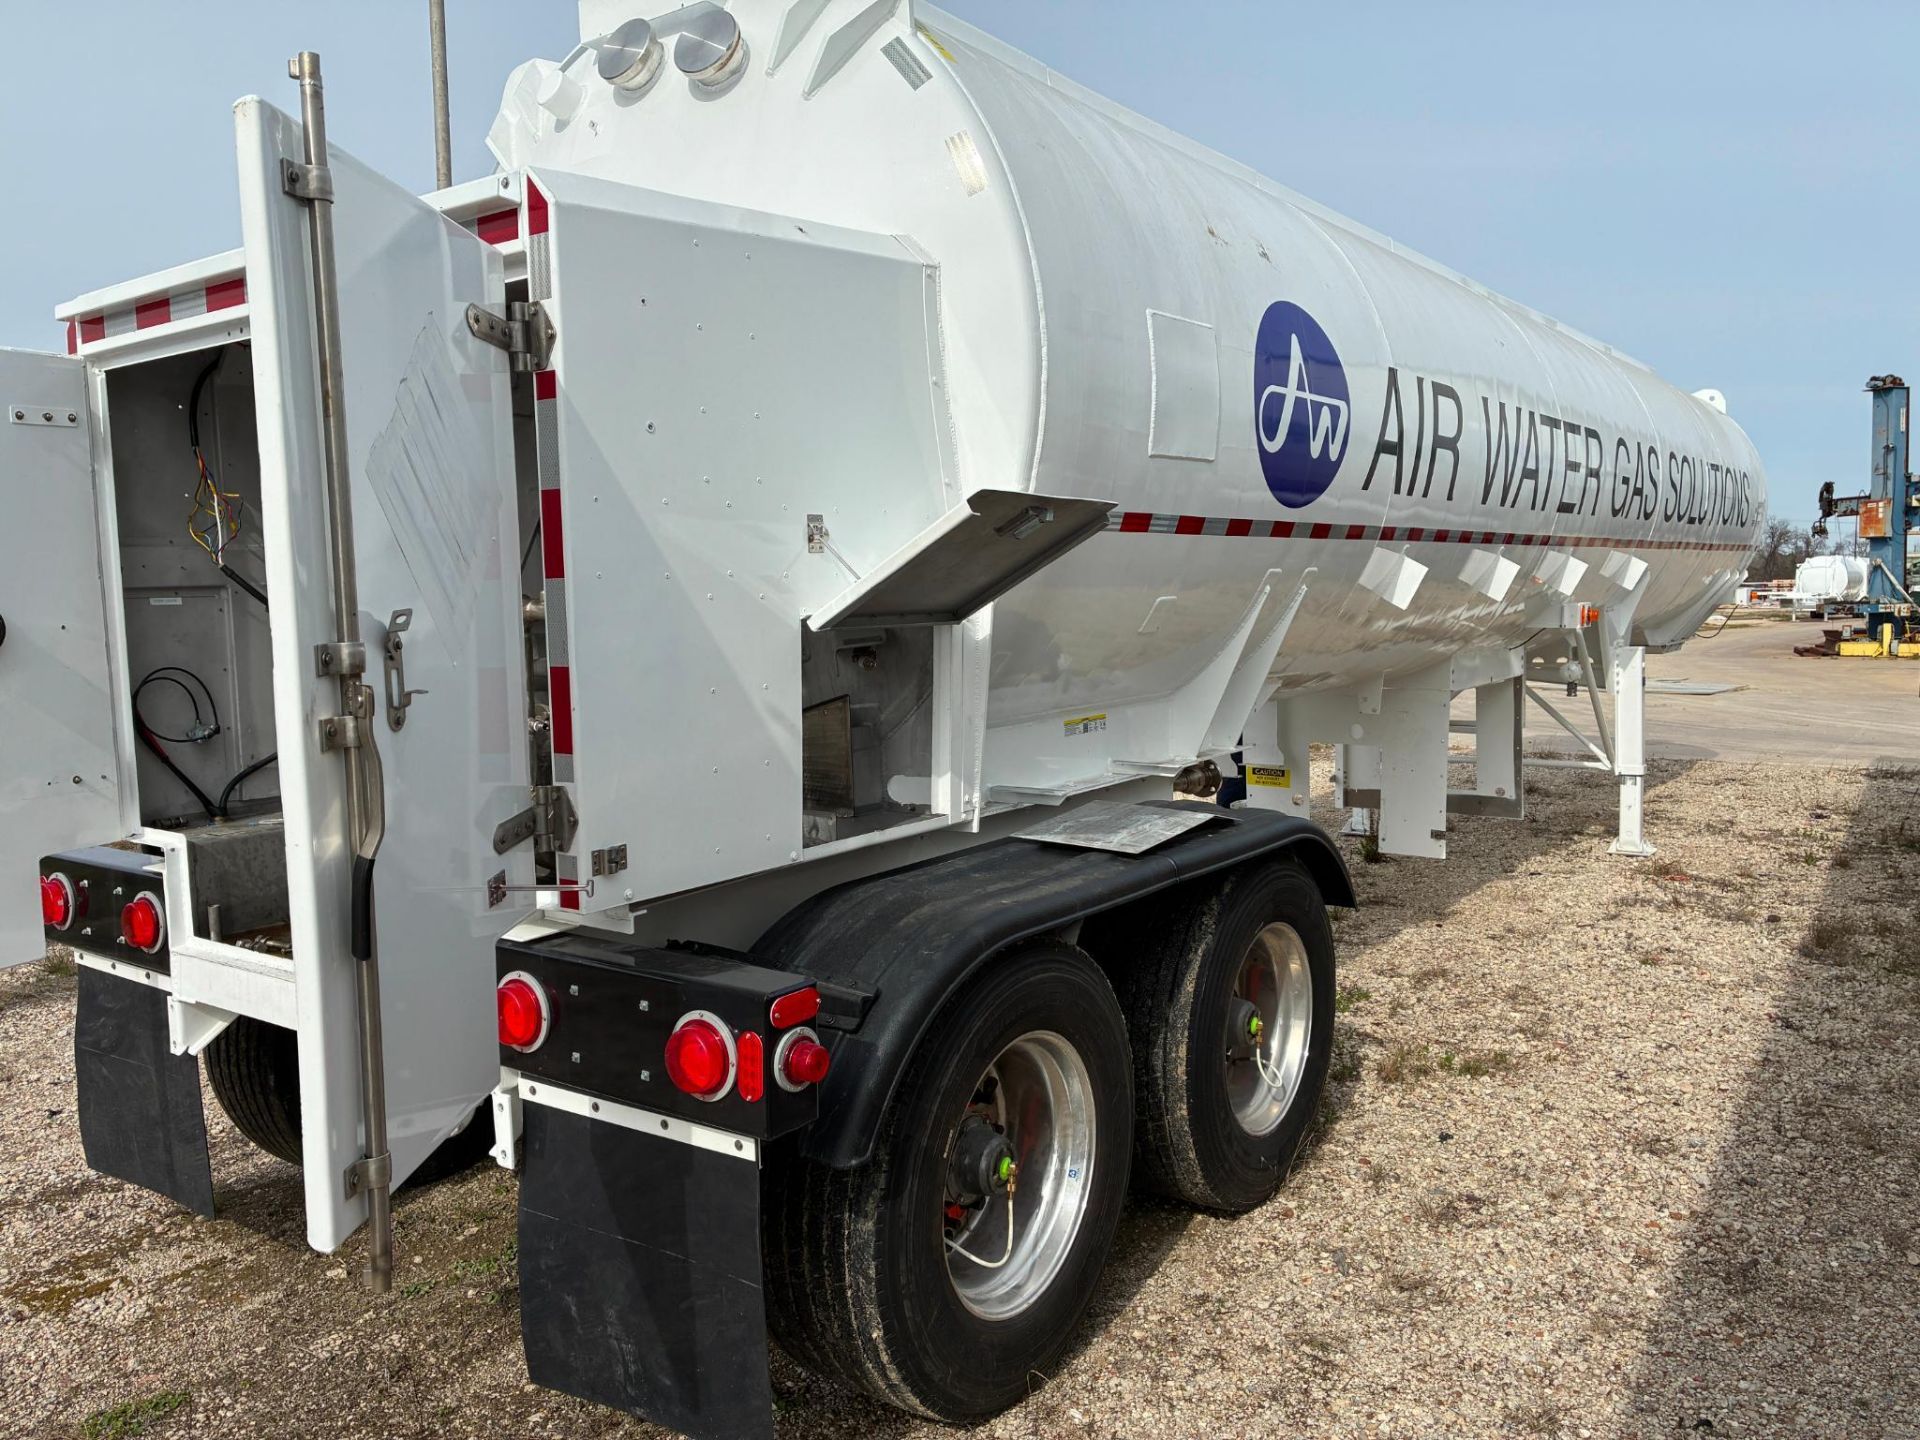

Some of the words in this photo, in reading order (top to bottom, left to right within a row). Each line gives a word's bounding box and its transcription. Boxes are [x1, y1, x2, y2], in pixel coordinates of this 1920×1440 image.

[1361, 366, 1463, 501] AIR
[1480, 395, 1603, 516] WATER
[1611, 437, 1660, 521] GAS
[1664, 451, 1750, 528] SOLUTIONS
[1254, 768, 1283, 777] CAUTION
